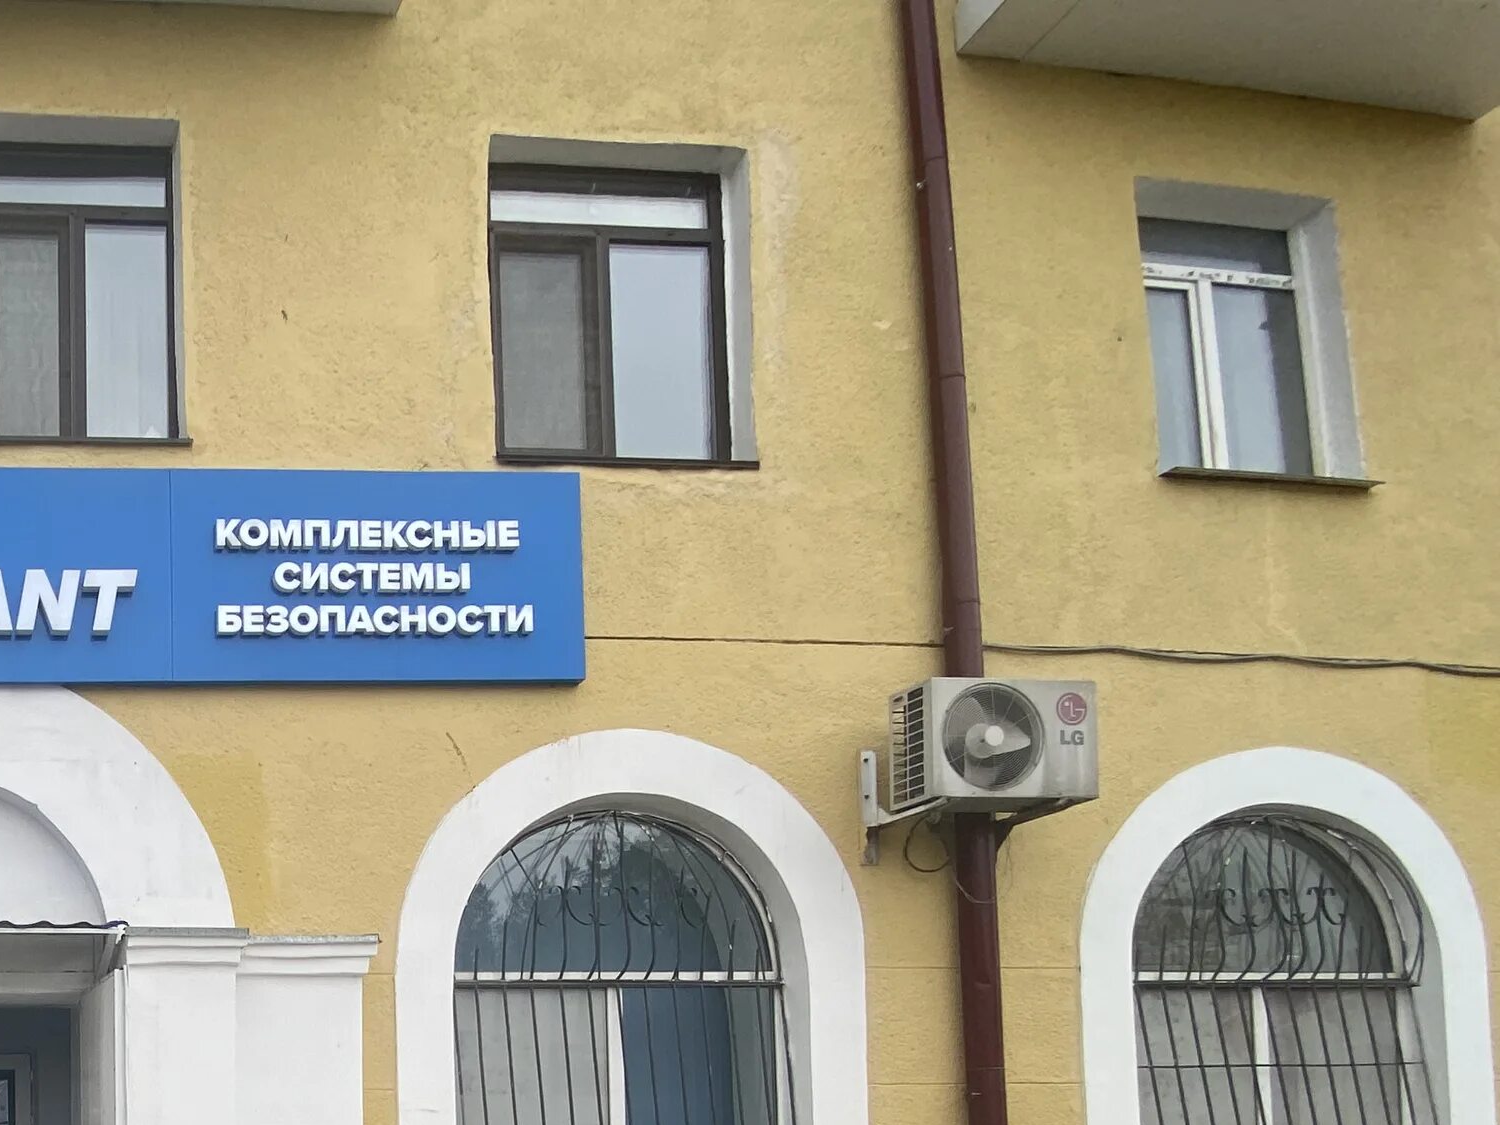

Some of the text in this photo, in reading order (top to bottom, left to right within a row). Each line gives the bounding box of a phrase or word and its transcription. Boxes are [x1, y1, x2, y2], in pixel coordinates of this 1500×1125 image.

[214, 518, 521, 552] КОМПЛЕКСНЫЕ
[272, 562, 471, 596] СИСТЕМЫ
[216, 604, 535, 639] БЕЗОПАСНОСТИ
[1060, 730, 1085, 746] LG
